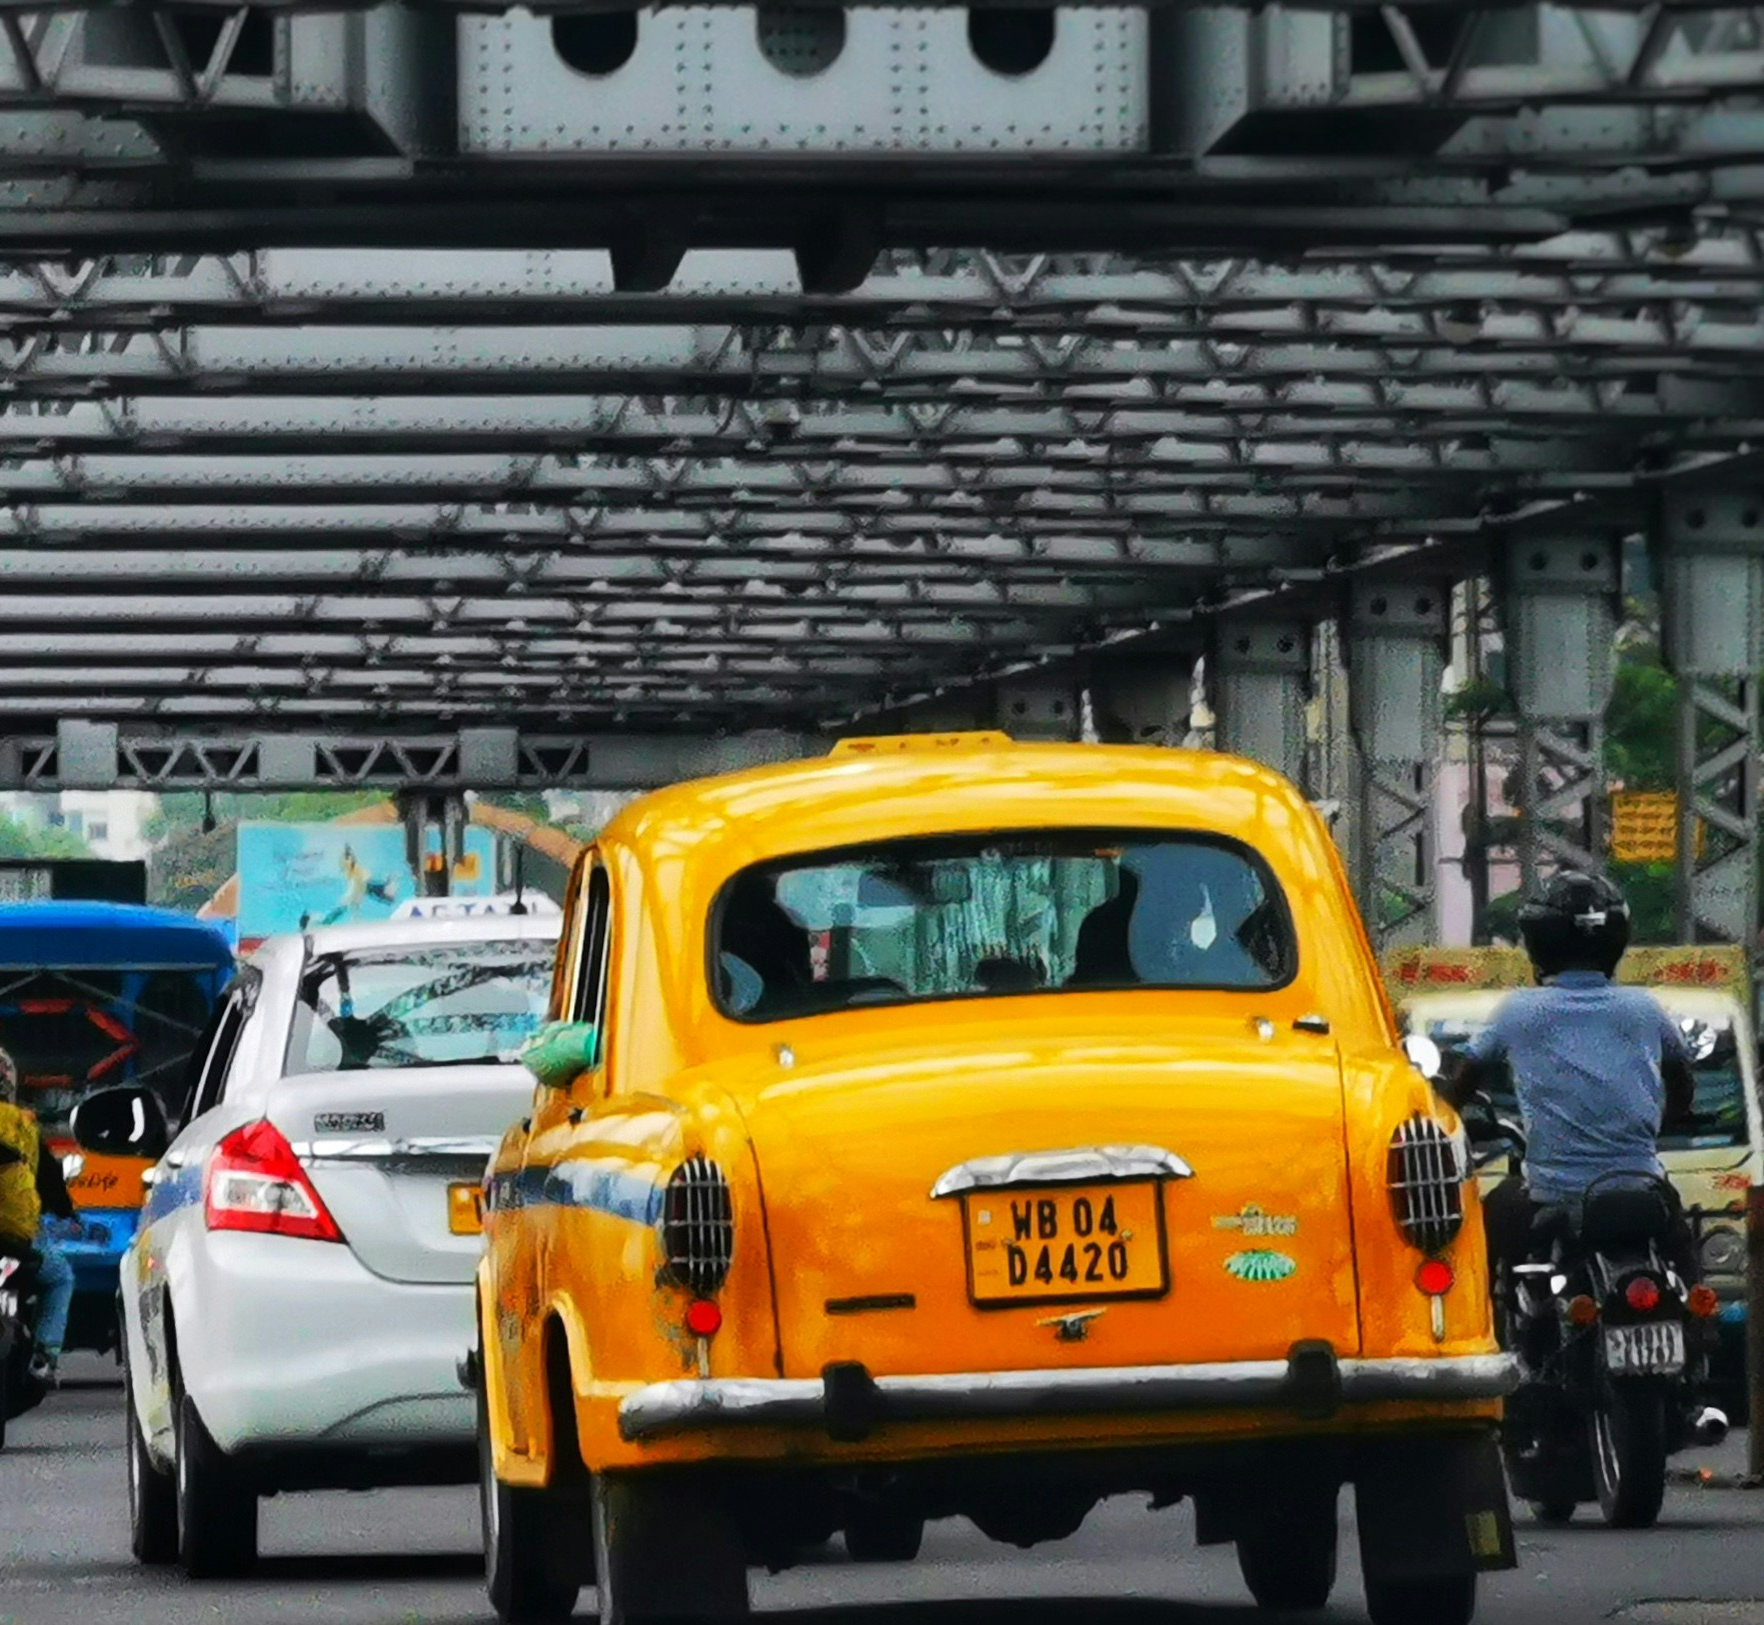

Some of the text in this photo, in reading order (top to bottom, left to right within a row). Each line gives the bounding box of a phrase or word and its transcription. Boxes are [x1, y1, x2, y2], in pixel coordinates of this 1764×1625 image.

[457, 901, 537, 917] TAI
[1010, 1194, 1118, 1241] WB 04
[1006, 1240, 1128, 1287] D4420
